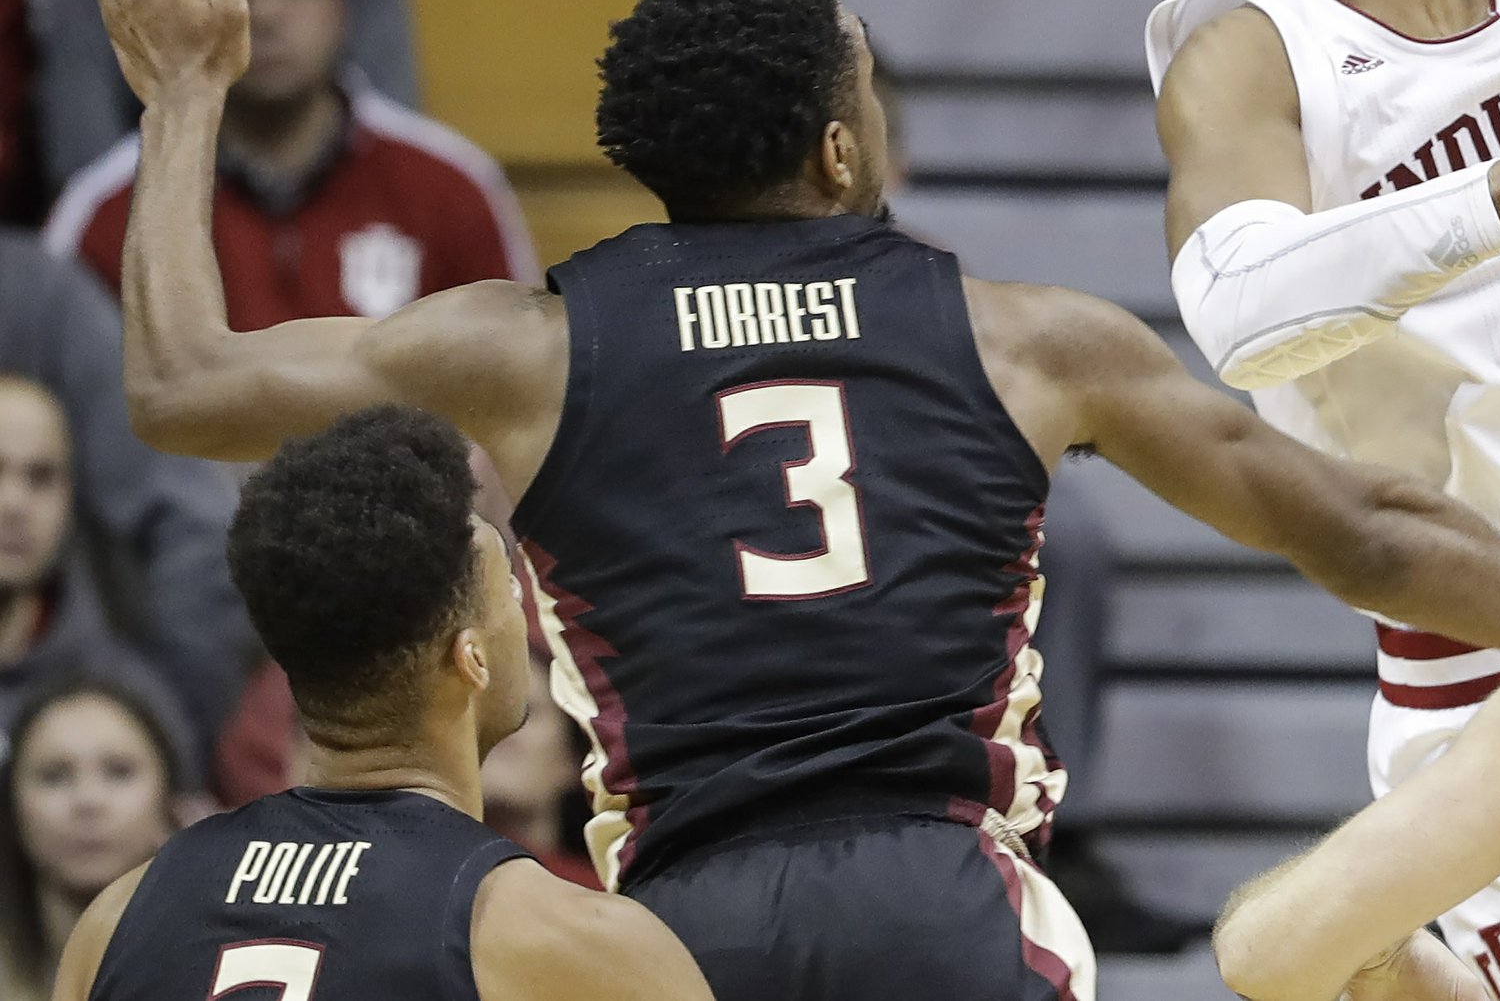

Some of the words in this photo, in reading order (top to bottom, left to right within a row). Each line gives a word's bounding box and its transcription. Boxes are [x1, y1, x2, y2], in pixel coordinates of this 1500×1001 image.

[673, 277, 862, 352] FORREST
[714, 378, 874, 601] 3
[225, 840, 373, 906] POLITE
